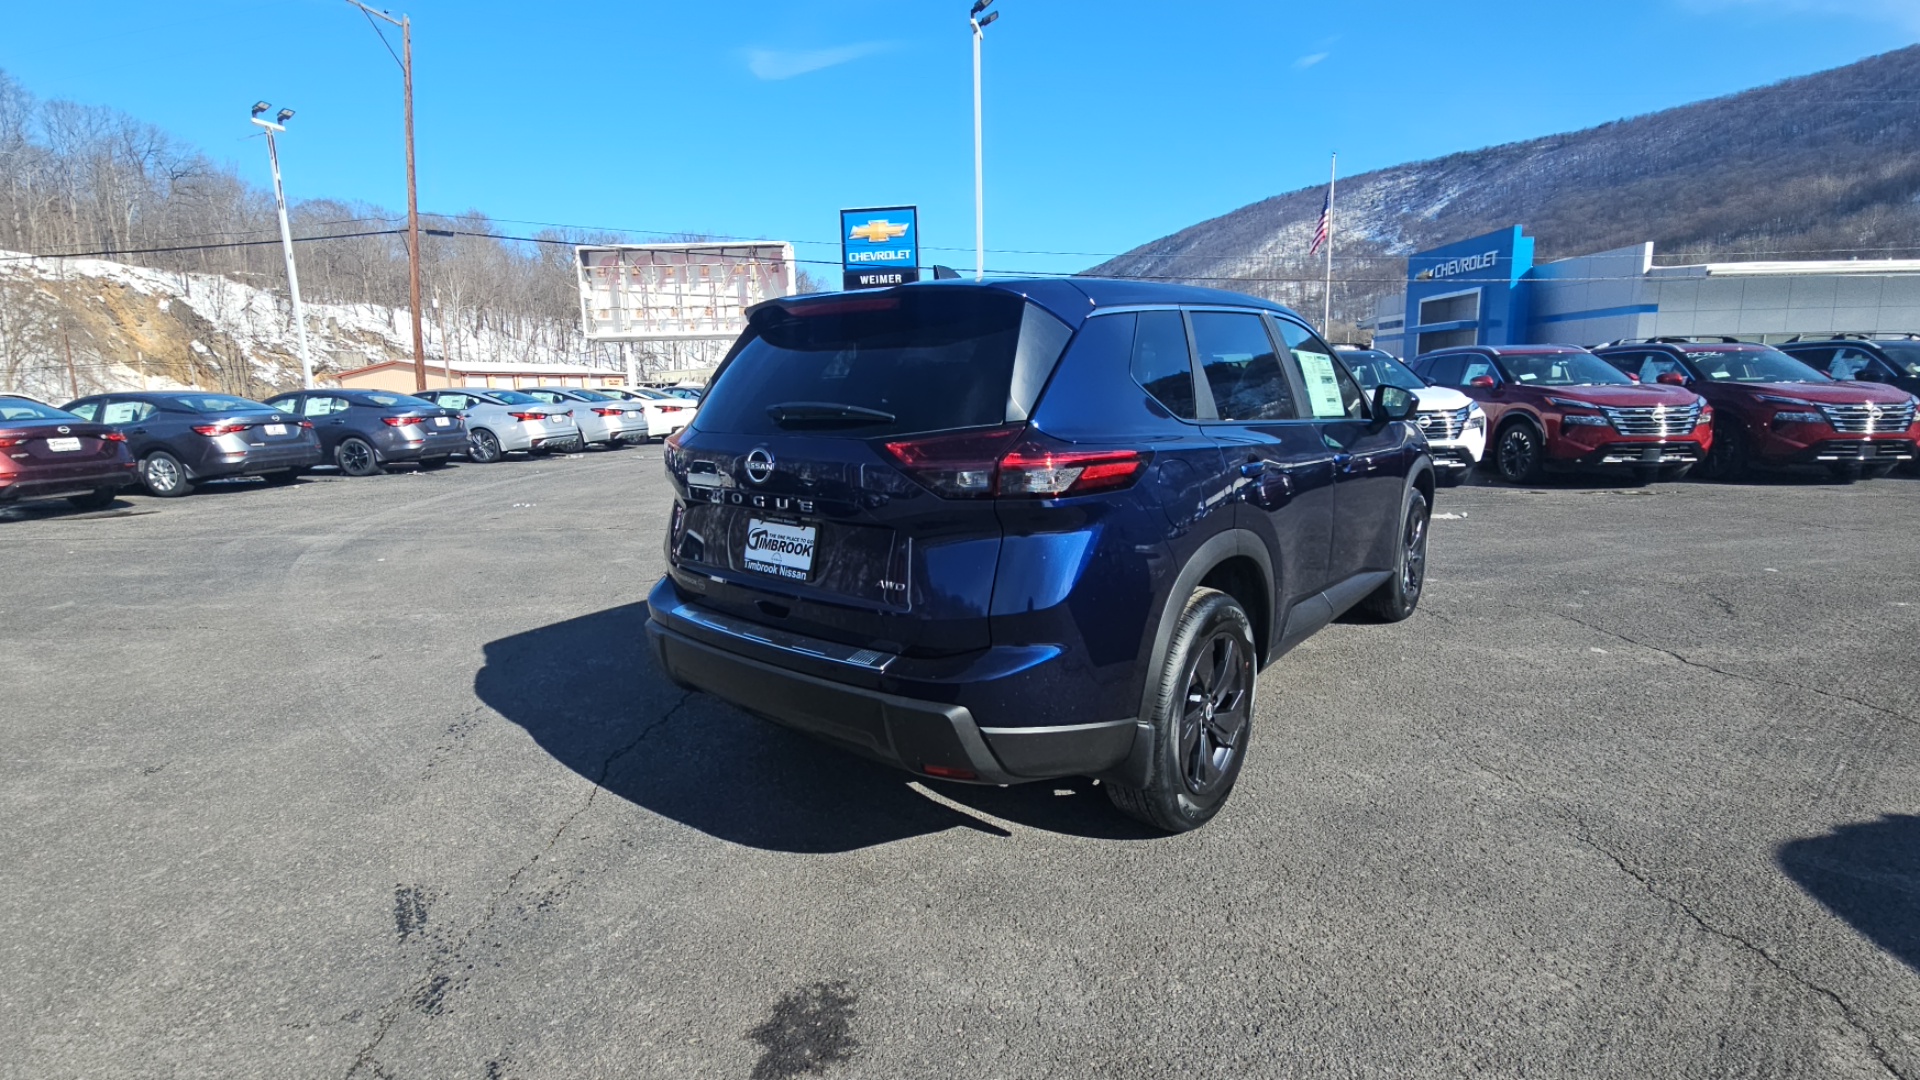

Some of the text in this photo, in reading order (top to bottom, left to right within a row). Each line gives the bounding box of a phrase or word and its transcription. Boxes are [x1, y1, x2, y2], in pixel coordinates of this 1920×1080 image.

[848, 249, 911, 262] CHEVROLET
[1434, 250, 1499, 278] CHEVROLET
[860, 273, 902, 285] WEIMER
[710, 489, 814, 513] ROGUE
[747, 528, 813, 557] TIMBROOK
[744, 560, 807, 580] Timbrook Nissan
[875, 580, 906, 591] AWD
